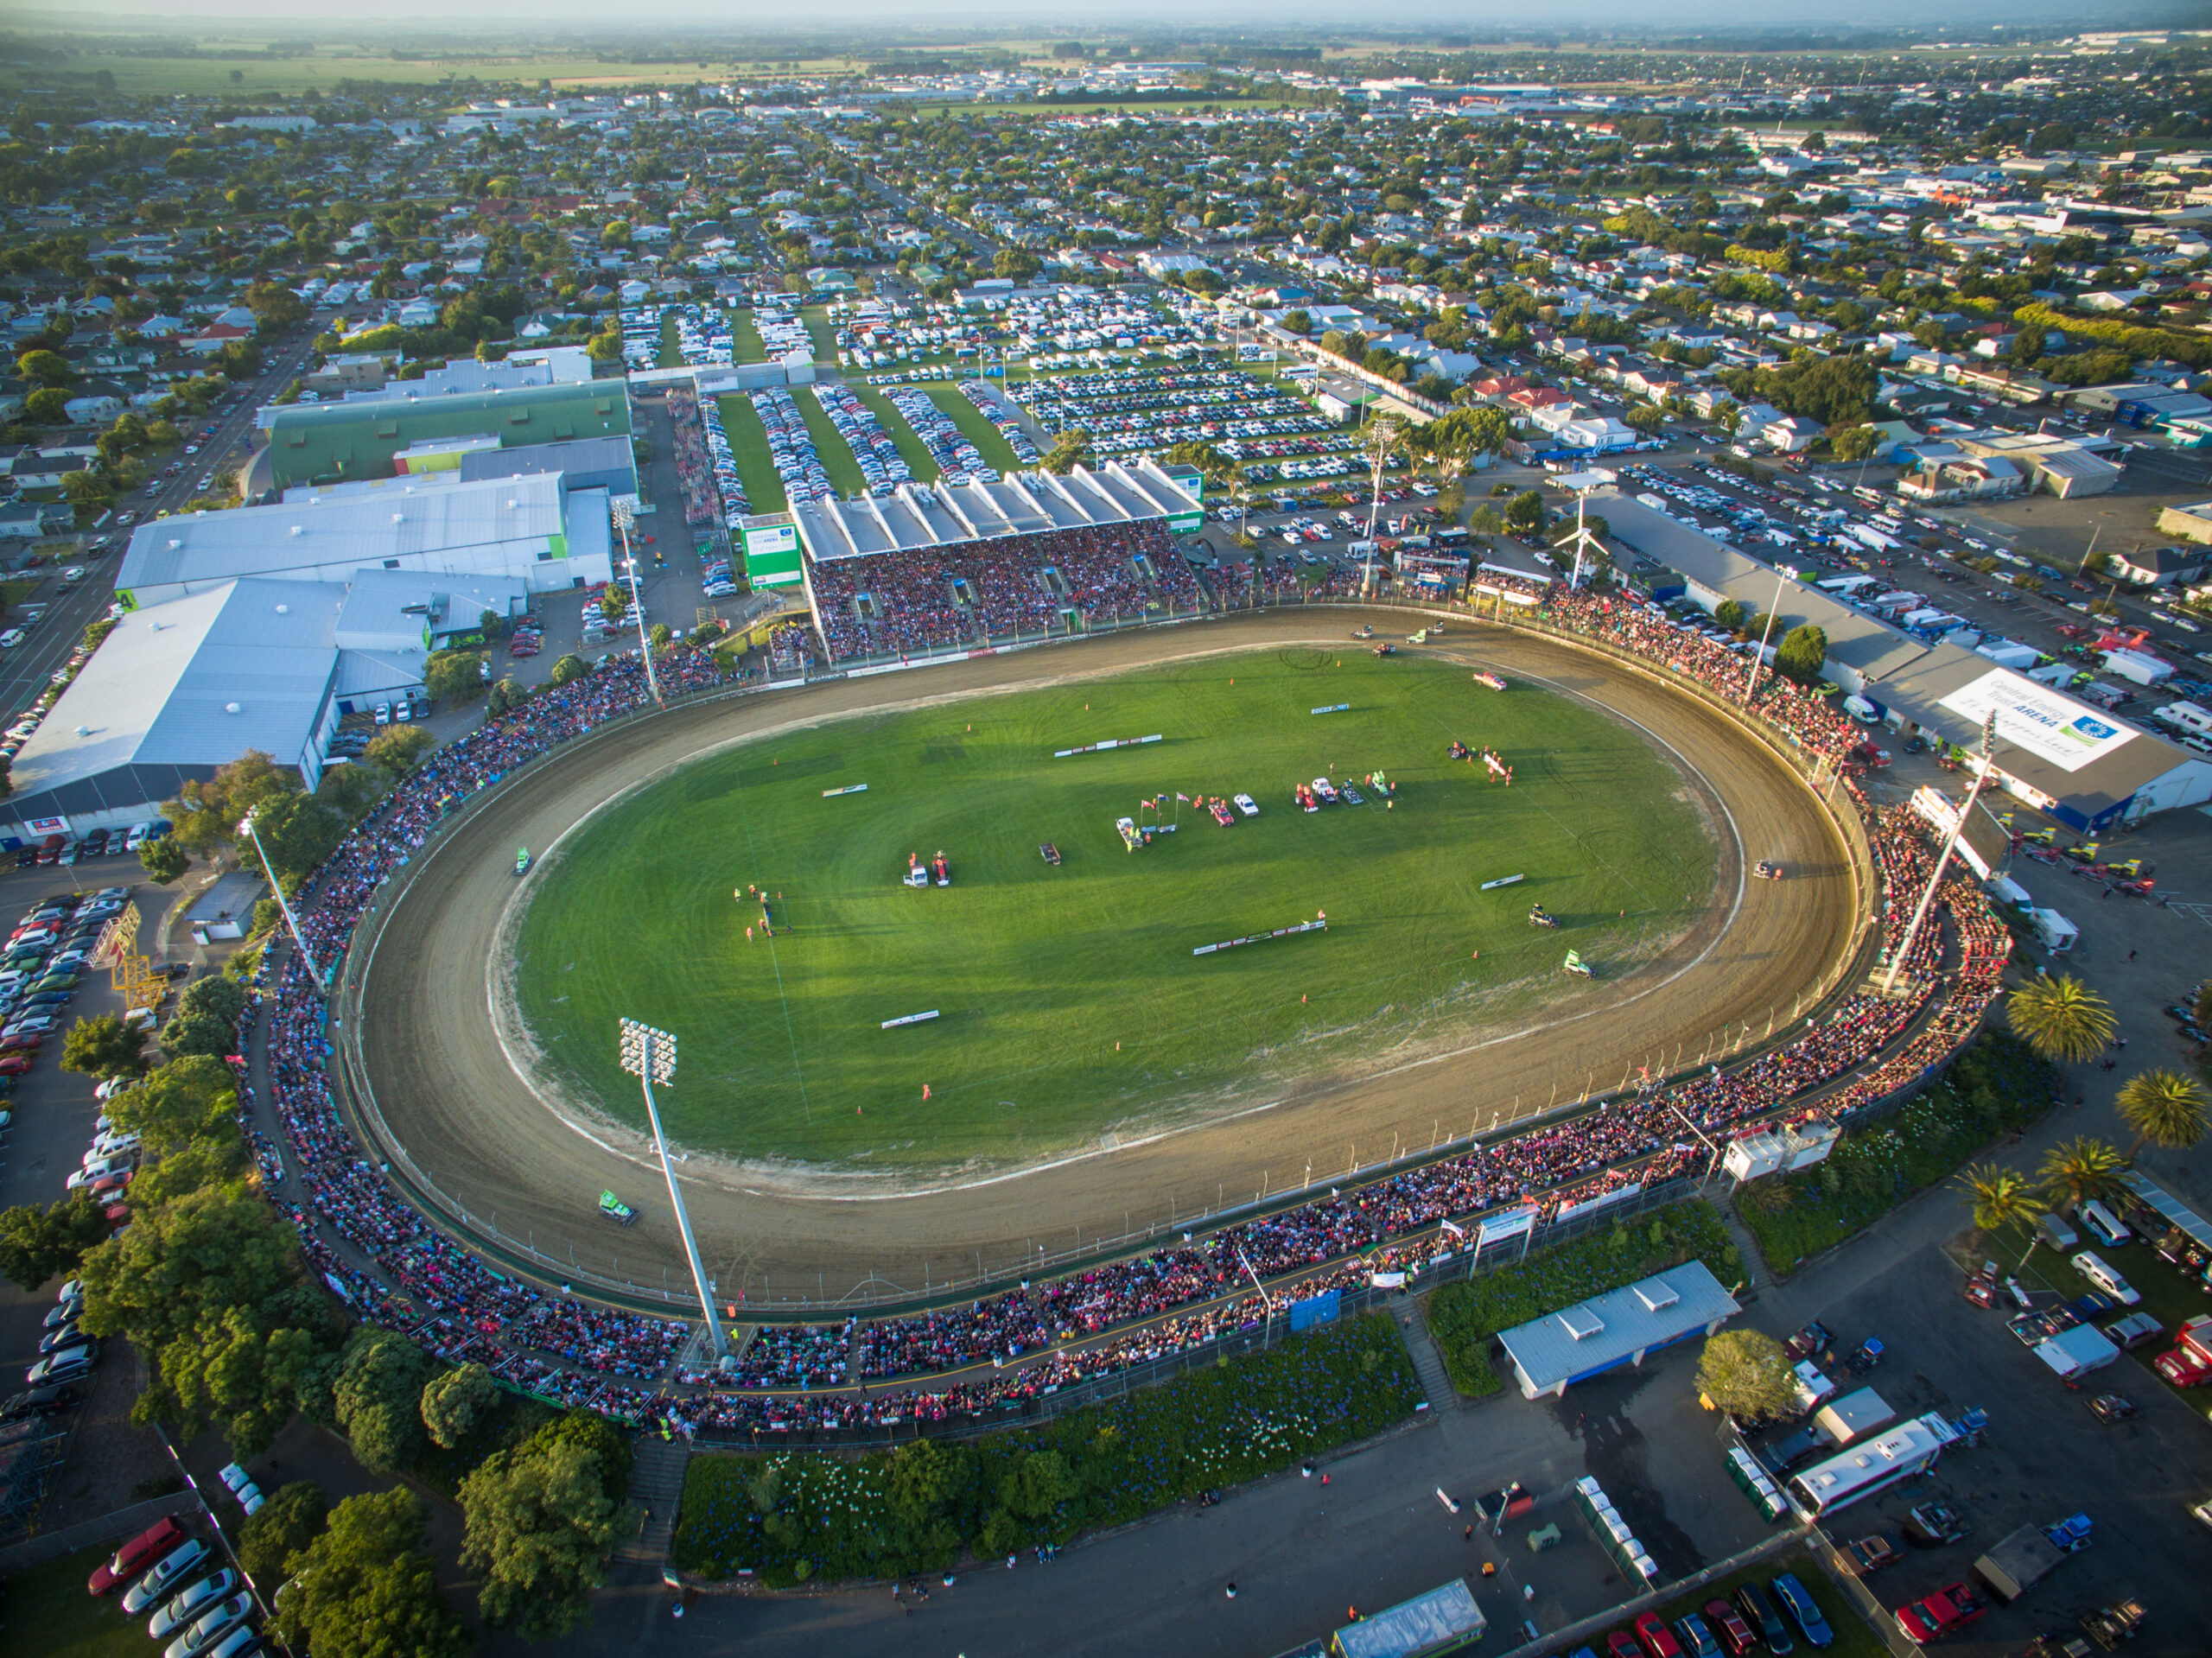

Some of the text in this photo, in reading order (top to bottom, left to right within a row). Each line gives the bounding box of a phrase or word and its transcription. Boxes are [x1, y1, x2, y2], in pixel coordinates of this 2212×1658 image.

[121, 594, 133, 609] 4
[1988, 689, 2018, 707] Trust
[2013, 705, 2059, 727] ARENA
[1990, 680, 2070, 721] Central Energy
[1955, 746, 1963, 757] 5
